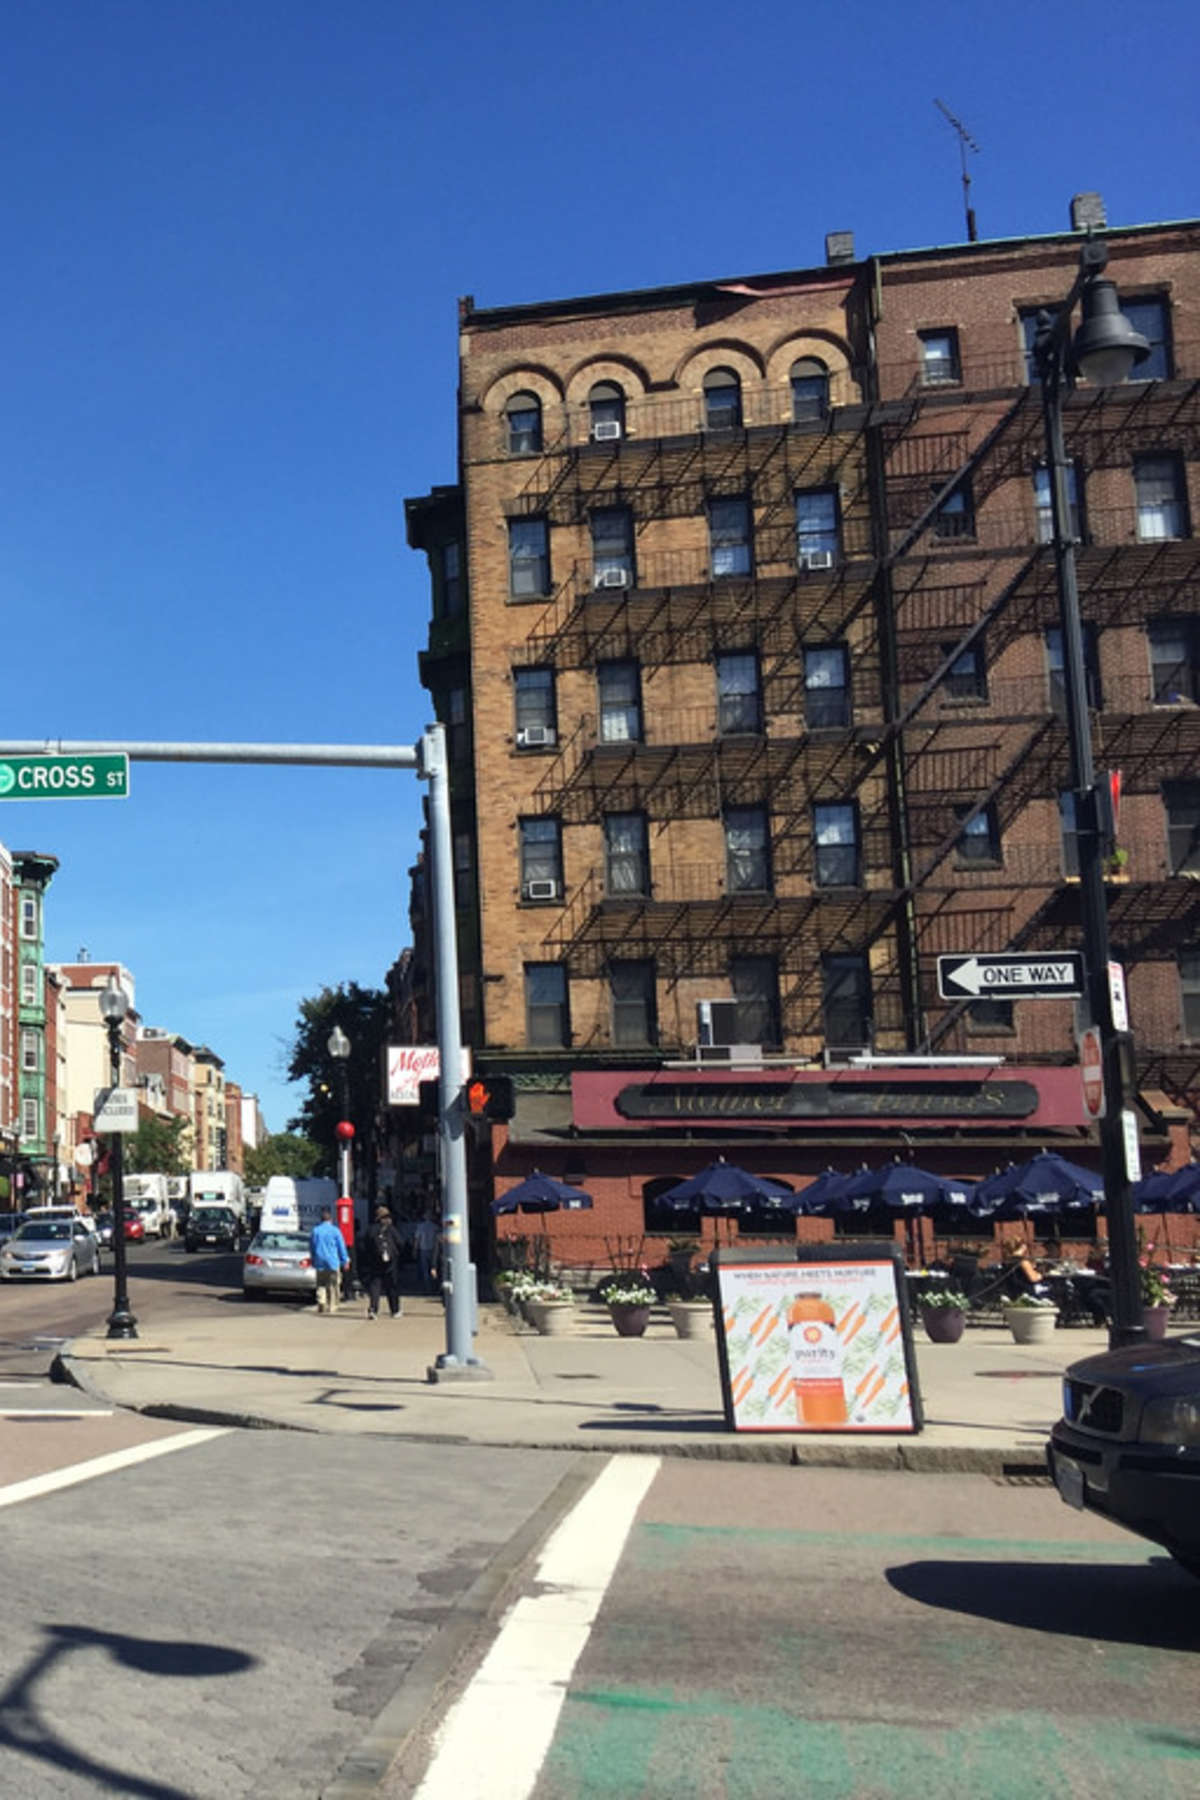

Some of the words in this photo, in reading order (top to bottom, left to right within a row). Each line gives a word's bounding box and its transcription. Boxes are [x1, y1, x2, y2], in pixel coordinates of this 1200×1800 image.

[17, 765, 96, 789] CROSS
[106, 771, 125, 787] ST
[983, 967, 1023, 983] ONE
[1028, 964, 1068, 982] WAY
